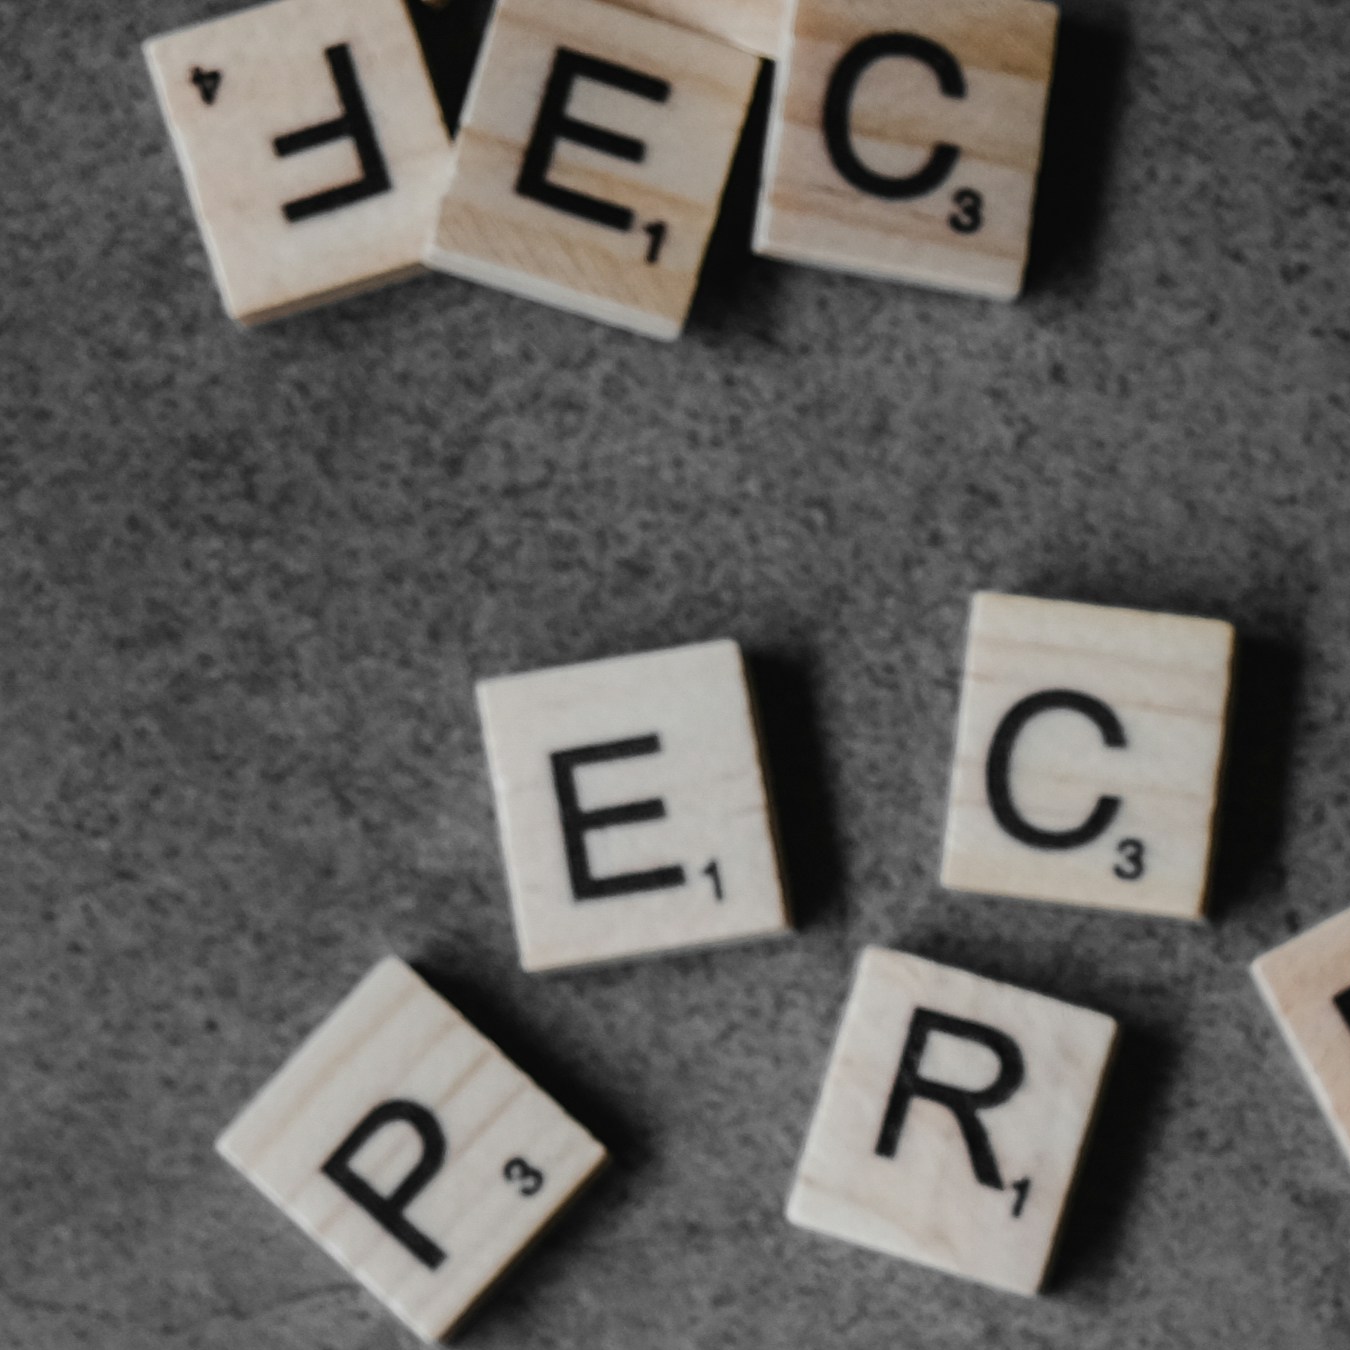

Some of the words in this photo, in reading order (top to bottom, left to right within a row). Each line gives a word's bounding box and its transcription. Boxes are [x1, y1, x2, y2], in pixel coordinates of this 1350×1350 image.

[190, 66, 223, 106] 4
[513, 45, 672, 233] E
[640, 219, 669, 267] 1
[815, 29, 969, 203] C
[944, 186, 986, 237] 3
[550, 734, 685, 901] E
[704, 861, 723, 900] 1
[986, 689, 1127, 850] C
[1113, 838, 1145, 881] 3
[321, 1099, 447, 1270] P
[503, 1157, 544, 1197] 3
[875, 1007, 1025, 1190] R
[1011, 1177, 1031, 1218] 1
